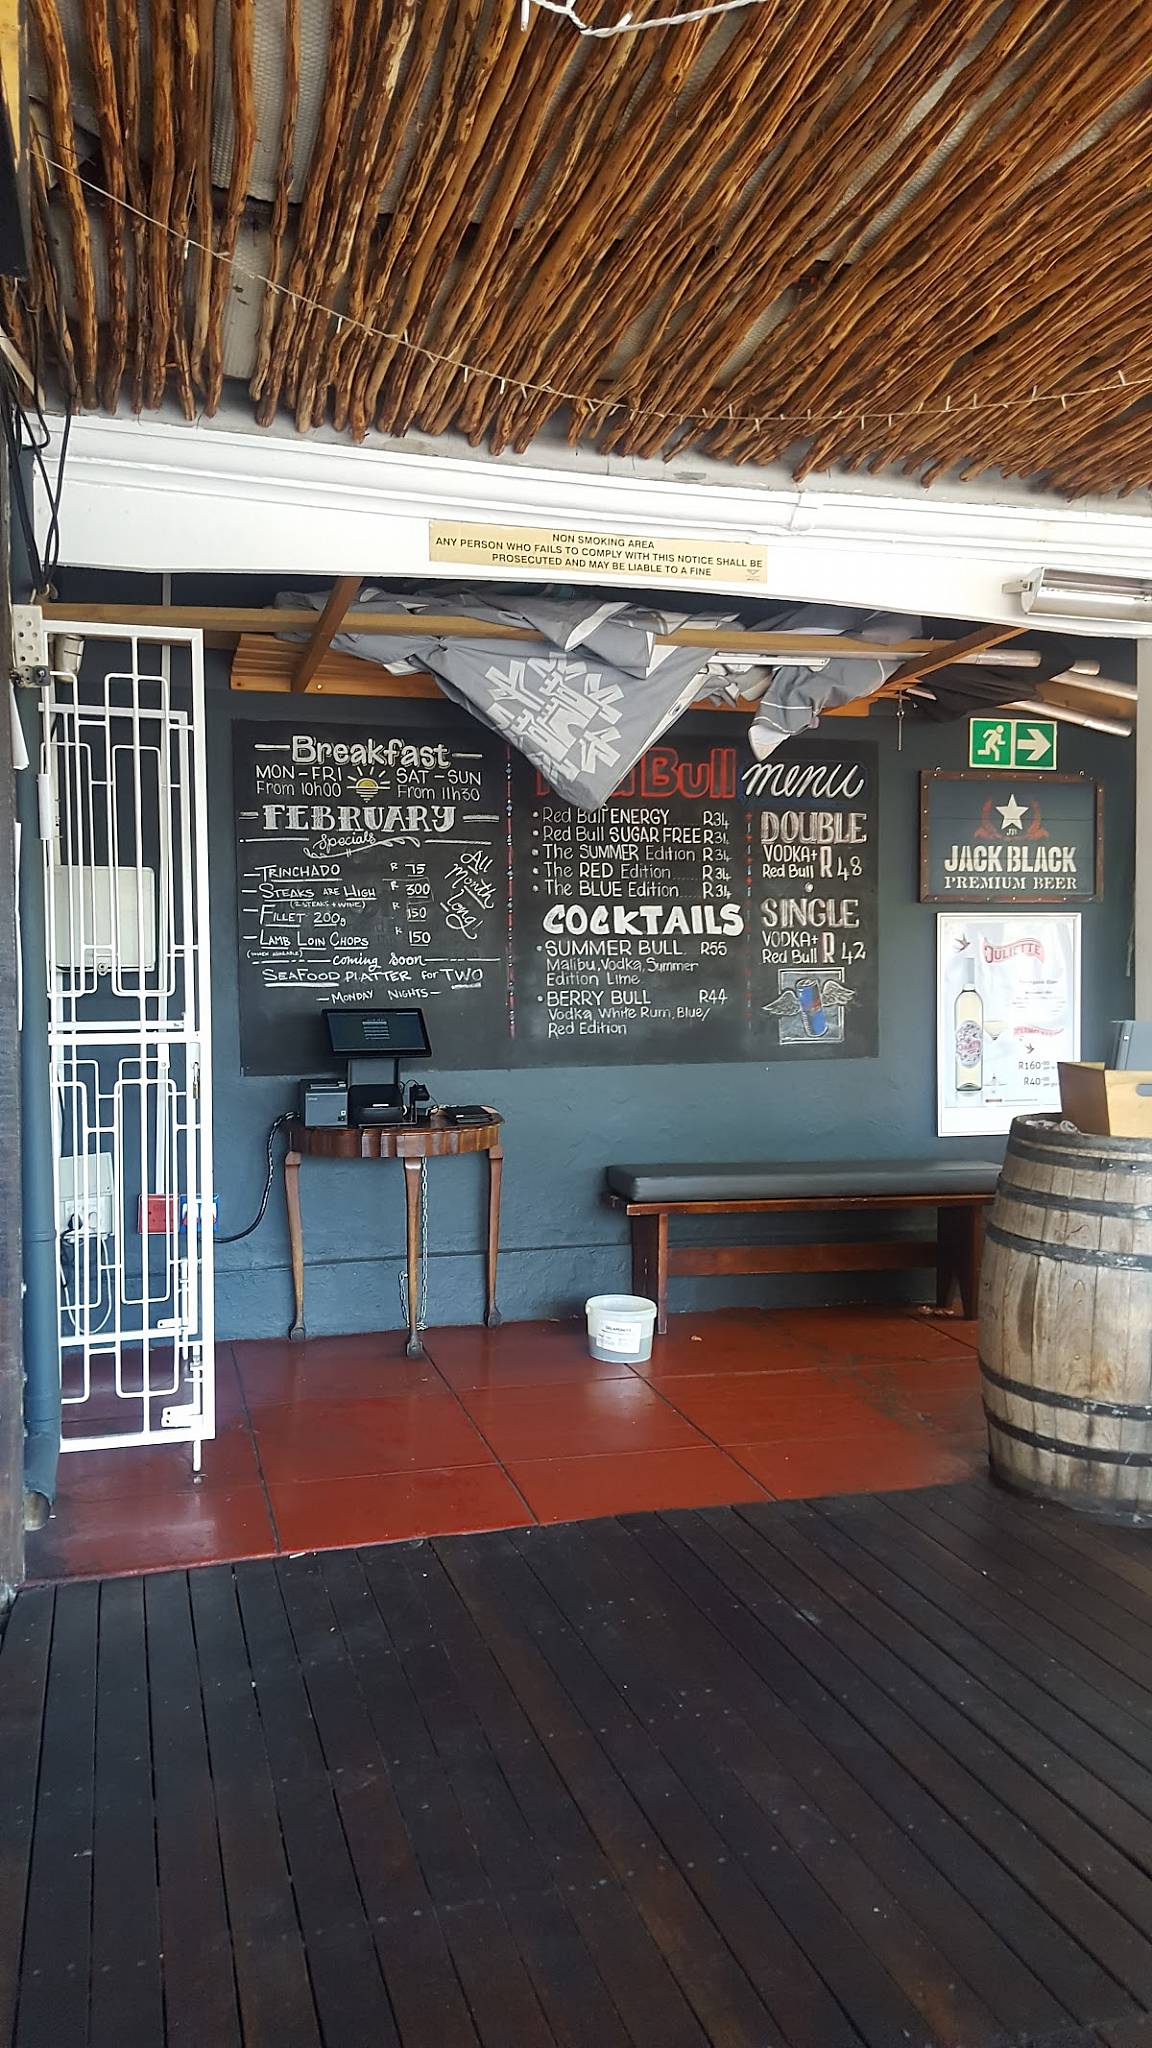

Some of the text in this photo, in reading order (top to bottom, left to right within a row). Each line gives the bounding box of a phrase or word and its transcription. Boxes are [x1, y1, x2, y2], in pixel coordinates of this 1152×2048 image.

[552, 533, 655, 549] NON SMOKING AREA
[435, 537, 763, 568] ANY PERSON WHO FAILS TO COMPLY WITH THIS NOTICE SHALL BE
[492, 553, 712, 577] PROSECUTED AND MAY BE LIABLE TO A FINE
[292, 735, 452, 768] Breakfast
[638, 746, 737, 799] Bull
[256, 780, 480, 801] From 10h00 From 11h30
[262, 804, 457, 833] FEBRUARY
[542, 806, 729, 829] Red Bull ENERGY R34
[760, 810, 868, 844] DOUBLE
[543, 825, 572, 842] Red
[575, 826, 605, 841] Bull
[609, 827, 660, 844] SUGAR
[662, 828, 701, 844] FREE
[542, 843, 574, 859] The
[579, 845, 639, 860] SUMMER
[645, 846, 695, 862] Edition
[944, 845, 1078, 874] JACK BLACK
[255, 864, 341, 883] TRINCHADO
[404, 863, 426, 877] 75
[460, 850, 493, 882] All
[543, 861, 731, 881] The RED Edition R34
[762, 863, 815, 879] Red Bull
[259, 882, 315, 900] STEAKS
[323, 887, 341, 897] ARE
[343, 884, 377, 899] HIGH
[405, 882, 430, 899] 300
[544, 879, 731, 899] The BLUE Edition R34
[944, 876, 1077, 890] PREMIUM BEER
[260, 904, 303, 926] FILLET
[406, 908, 427, 922] 150
[542, 903, 743, 937] COCKTAILS
[760, 898, 860, 929] SINGLE
[260, 925, 291, 947] LAMB
[297, 930, 327, 947] LOIN
[329, 931, 369, 949] CHOPS
[408, 930, 431, 946] 150
[544, 940, 632, 957] SUMMER
[700, 941, 728, 956] R55
[762, 948, 818, 965] Red Bull
[332, 951, 426, 972] coming soon
[646, 956, 699, 973] Summer
[440, 968, 483, 984] TWO
[546, 972, 640, 987] Edition Lime
[331, 990, 374, 1003] MONDAY
[547, 988, 728, 1007] BERRY BULL R44
[600, 1006, 637, 1019] White
[548, 1021, 628, 1040] Red Edition
[1018, 1060, 1041, 1071] R160
[1023, 1077, 1041, 1087] R40
